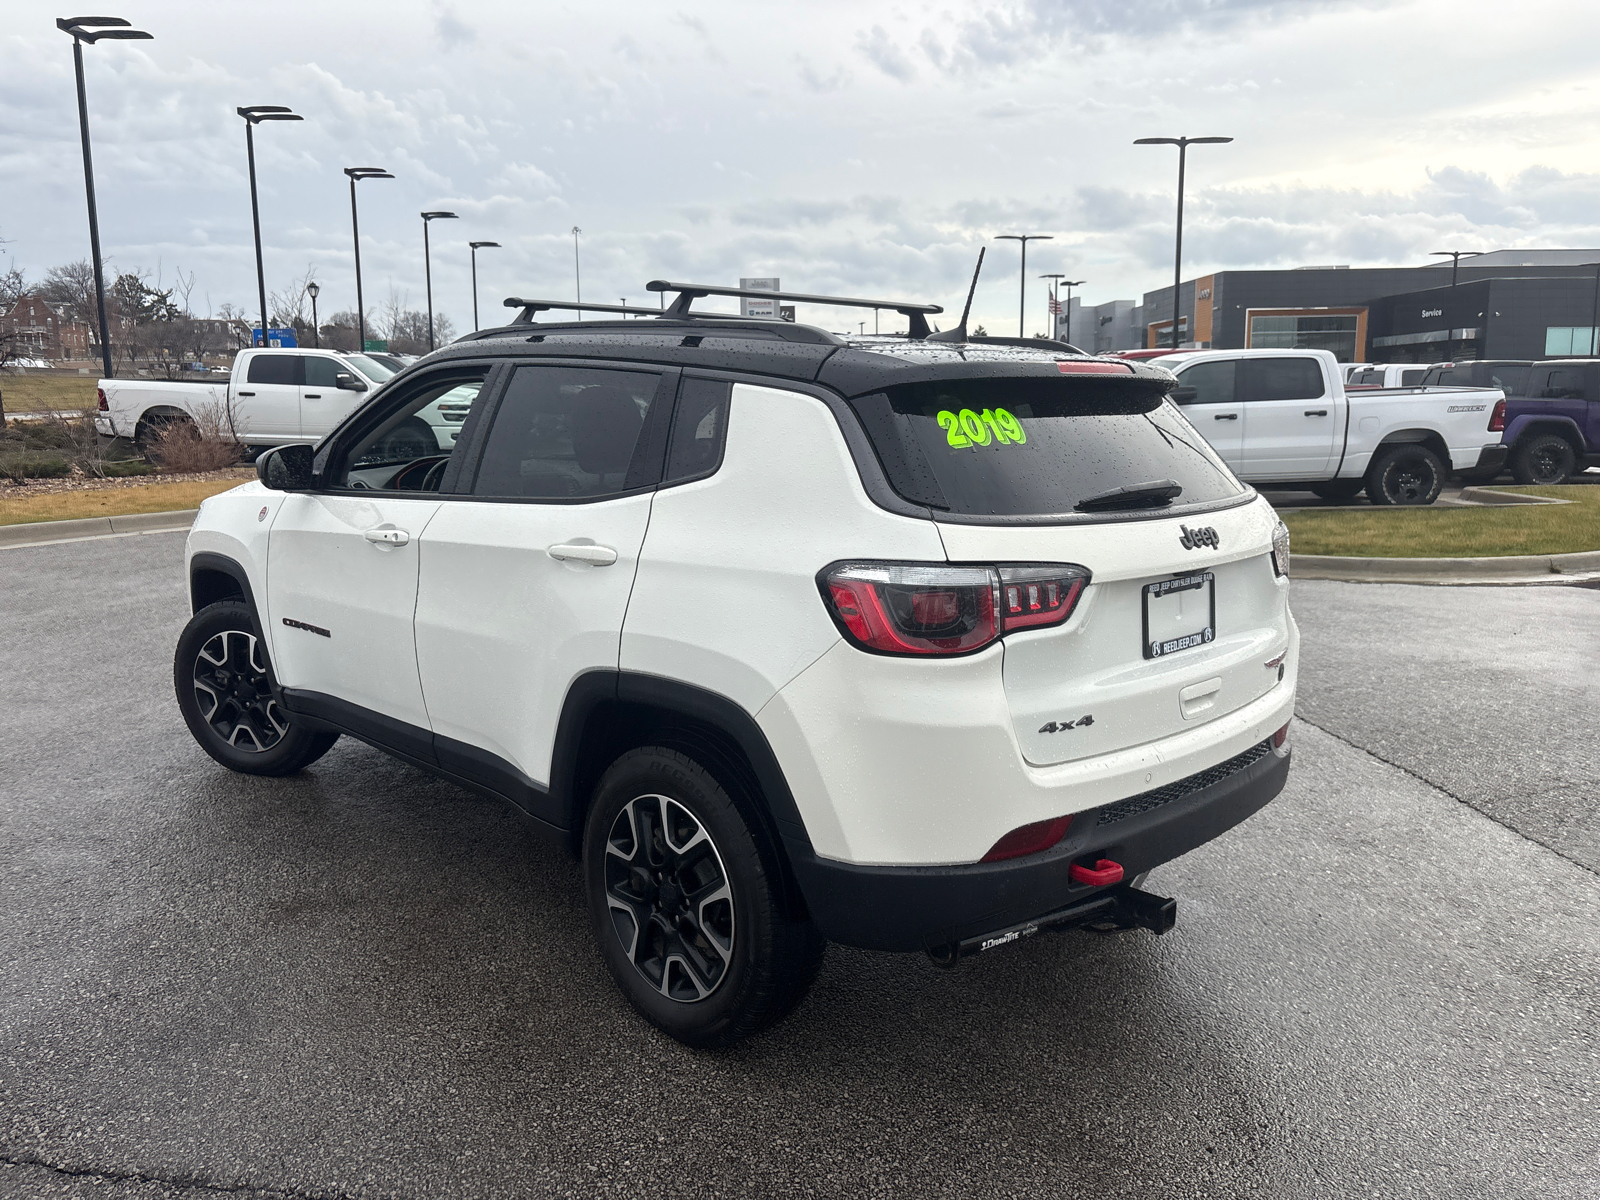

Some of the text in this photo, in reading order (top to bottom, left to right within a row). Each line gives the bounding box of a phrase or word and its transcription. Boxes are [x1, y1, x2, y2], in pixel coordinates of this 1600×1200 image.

[1421, 308, 1443, 318] Service
[937, 408, 1026, 449] 2019
[1179, 524, 1220, 550] Jeep
[1149, 572, 1213, 593] REED JEEP CHRYSLER DODGE RAM
[1163, 633, 1202, 654] REEDJEEP.COM
[1038, 714, 1095, 733] 4x4
